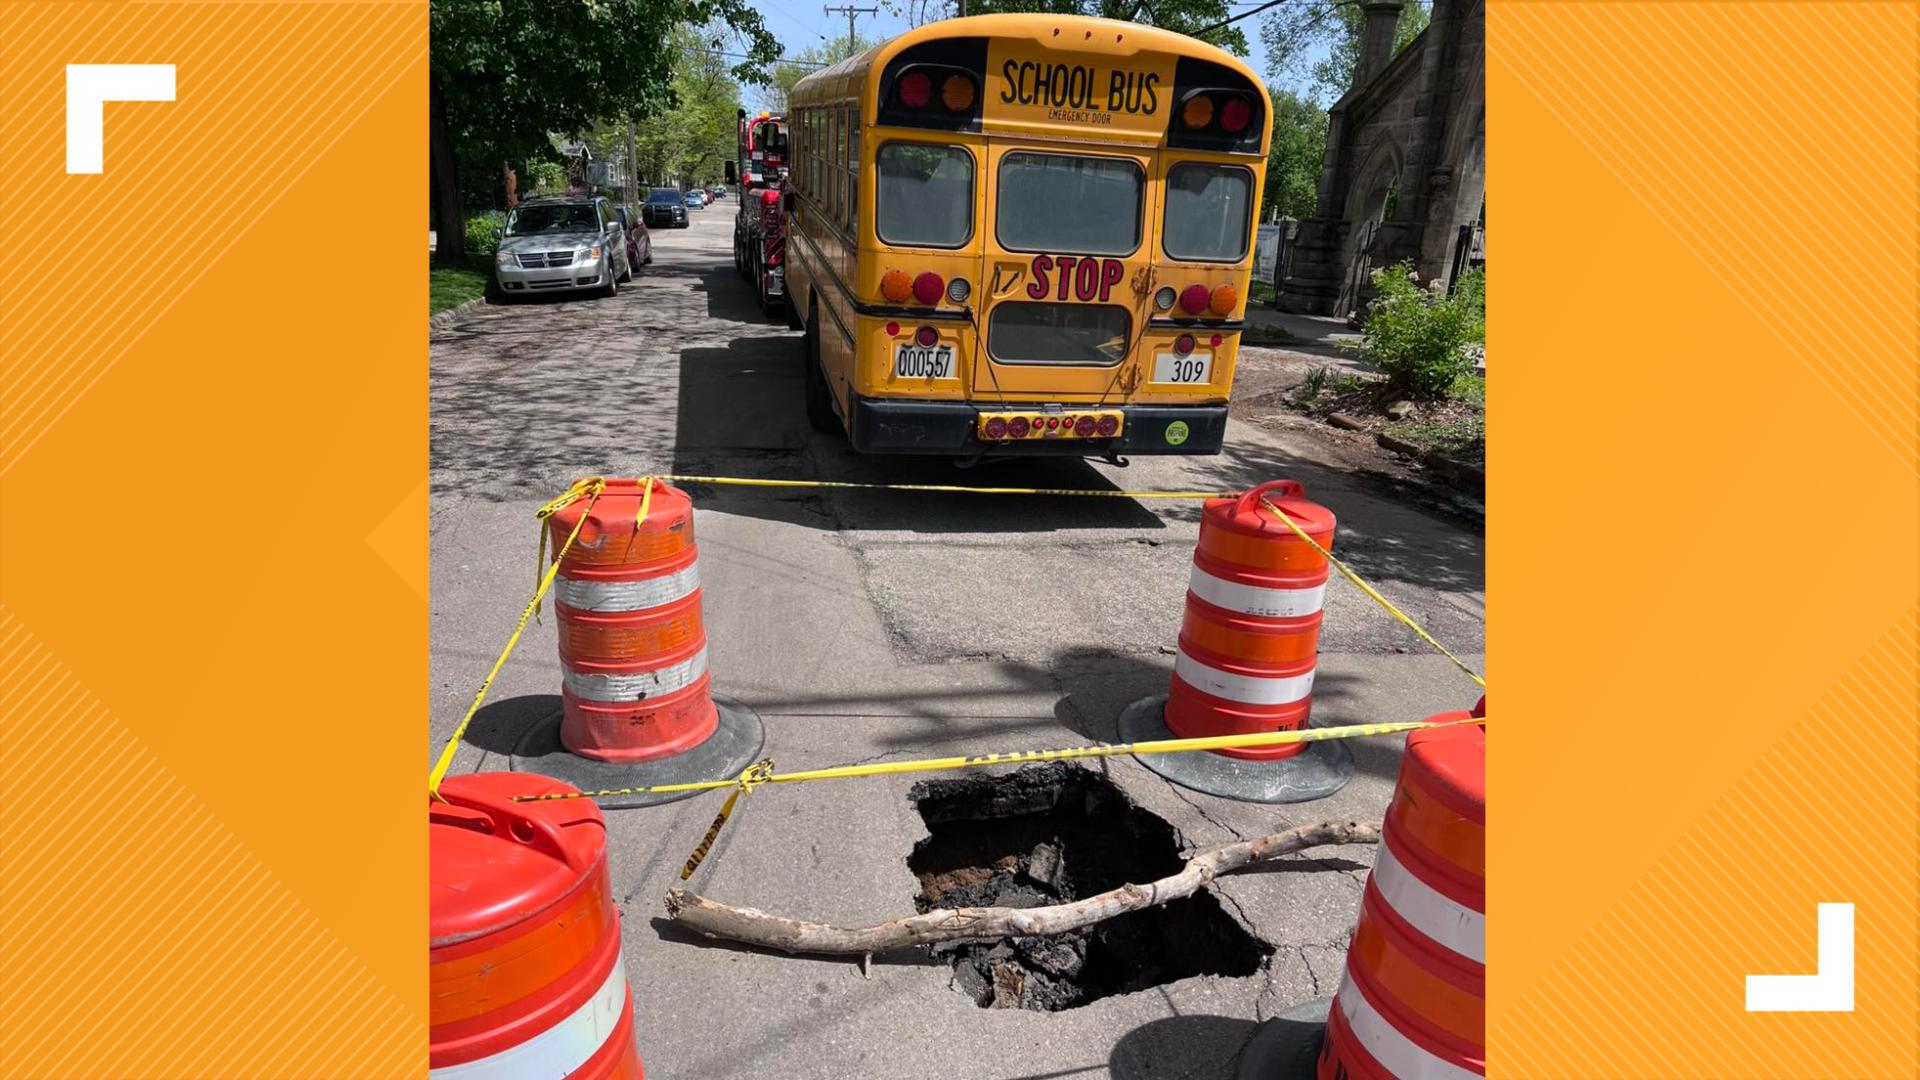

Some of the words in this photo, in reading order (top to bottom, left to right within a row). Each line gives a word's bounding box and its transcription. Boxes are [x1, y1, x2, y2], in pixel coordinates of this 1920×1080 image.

[1000, 59, 1100, 110] SCHOOL
[1107, 70, 1160, 115] BUS
[1048, 109, 1089, 123] EMERGENCY
[1091, 111, 1112, 125] DOOR
[1026, 254, 1125, 302] STOP
[1171, 360, 1204, 382] 309
